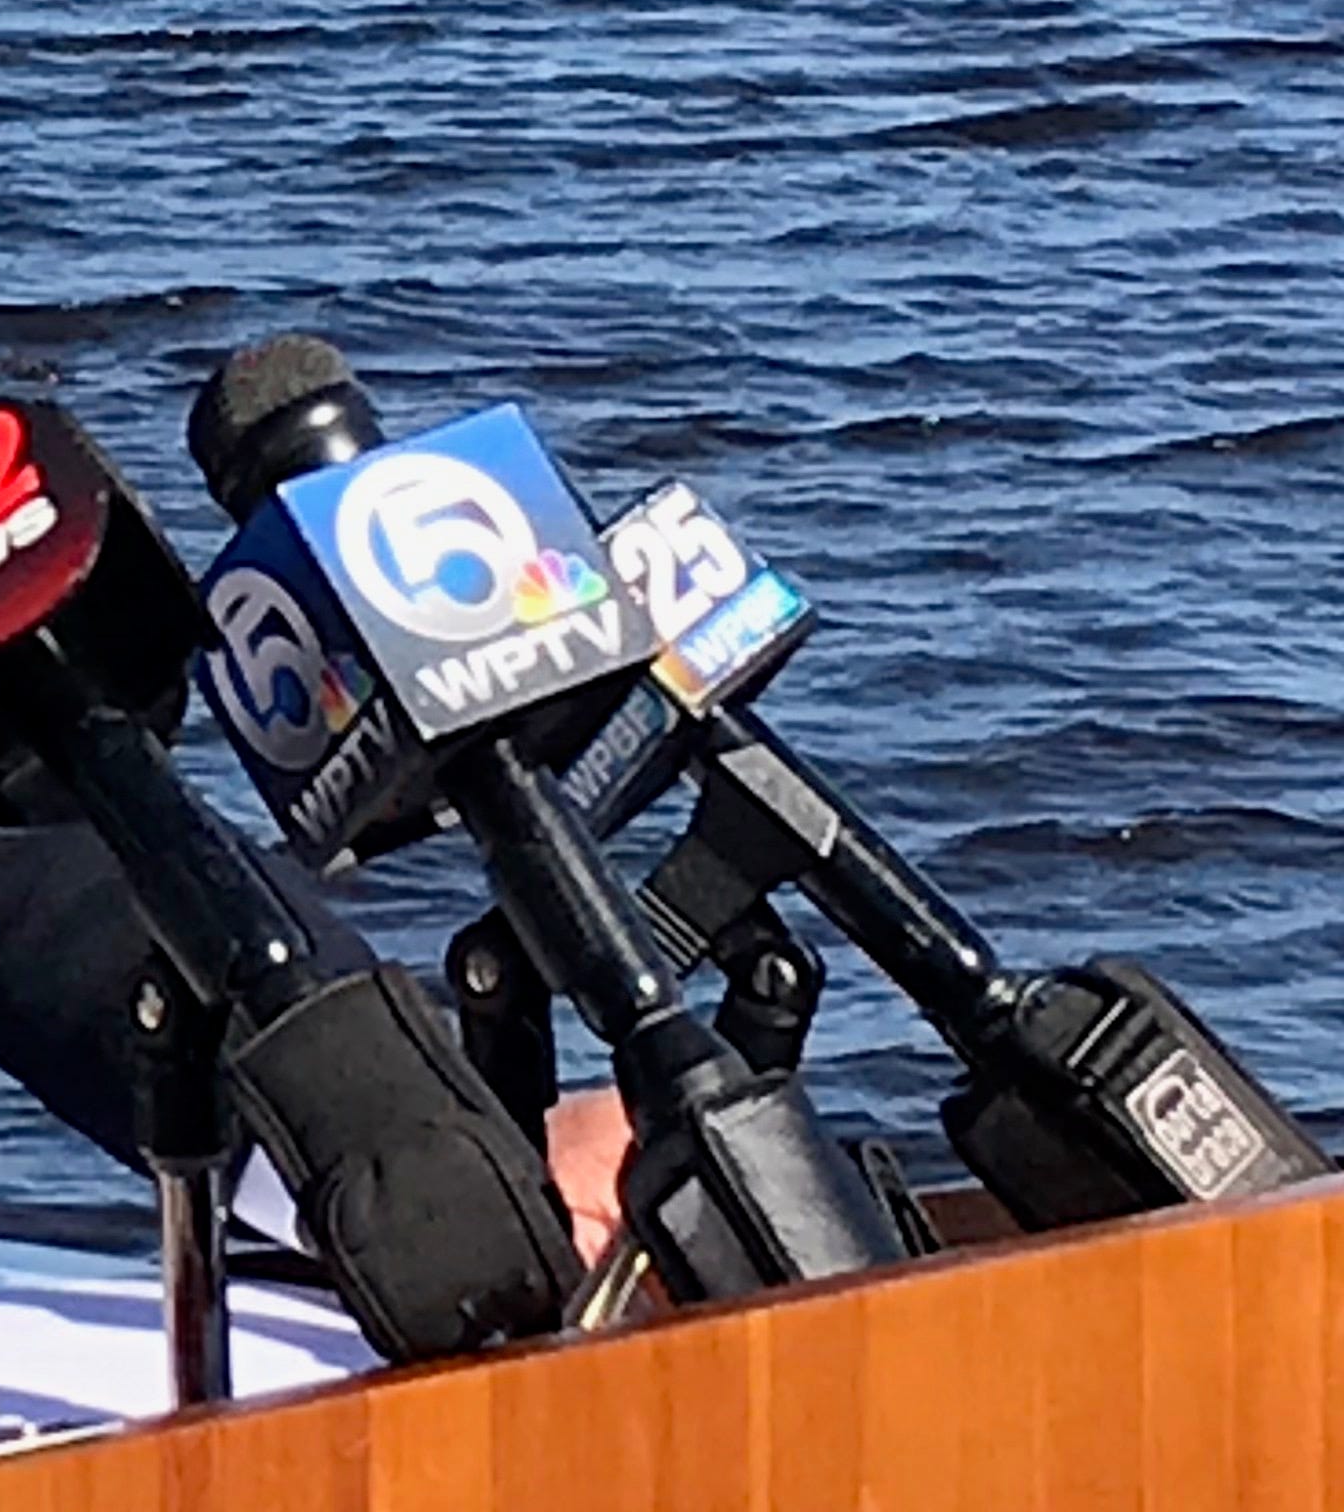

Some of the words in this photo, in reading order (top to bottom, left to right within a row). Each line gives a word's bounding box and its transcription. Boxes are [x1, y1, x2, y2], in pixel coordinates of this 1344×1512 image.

[344, 458, 540, 641] 5
[610, 482, 746, 642] 25
[209, 571, 329, 769] 5
[415, 599, 622, 712] WPTV
[289, 696, 397, 844] WPTV
[561, 686, 654, 809] WPBF
